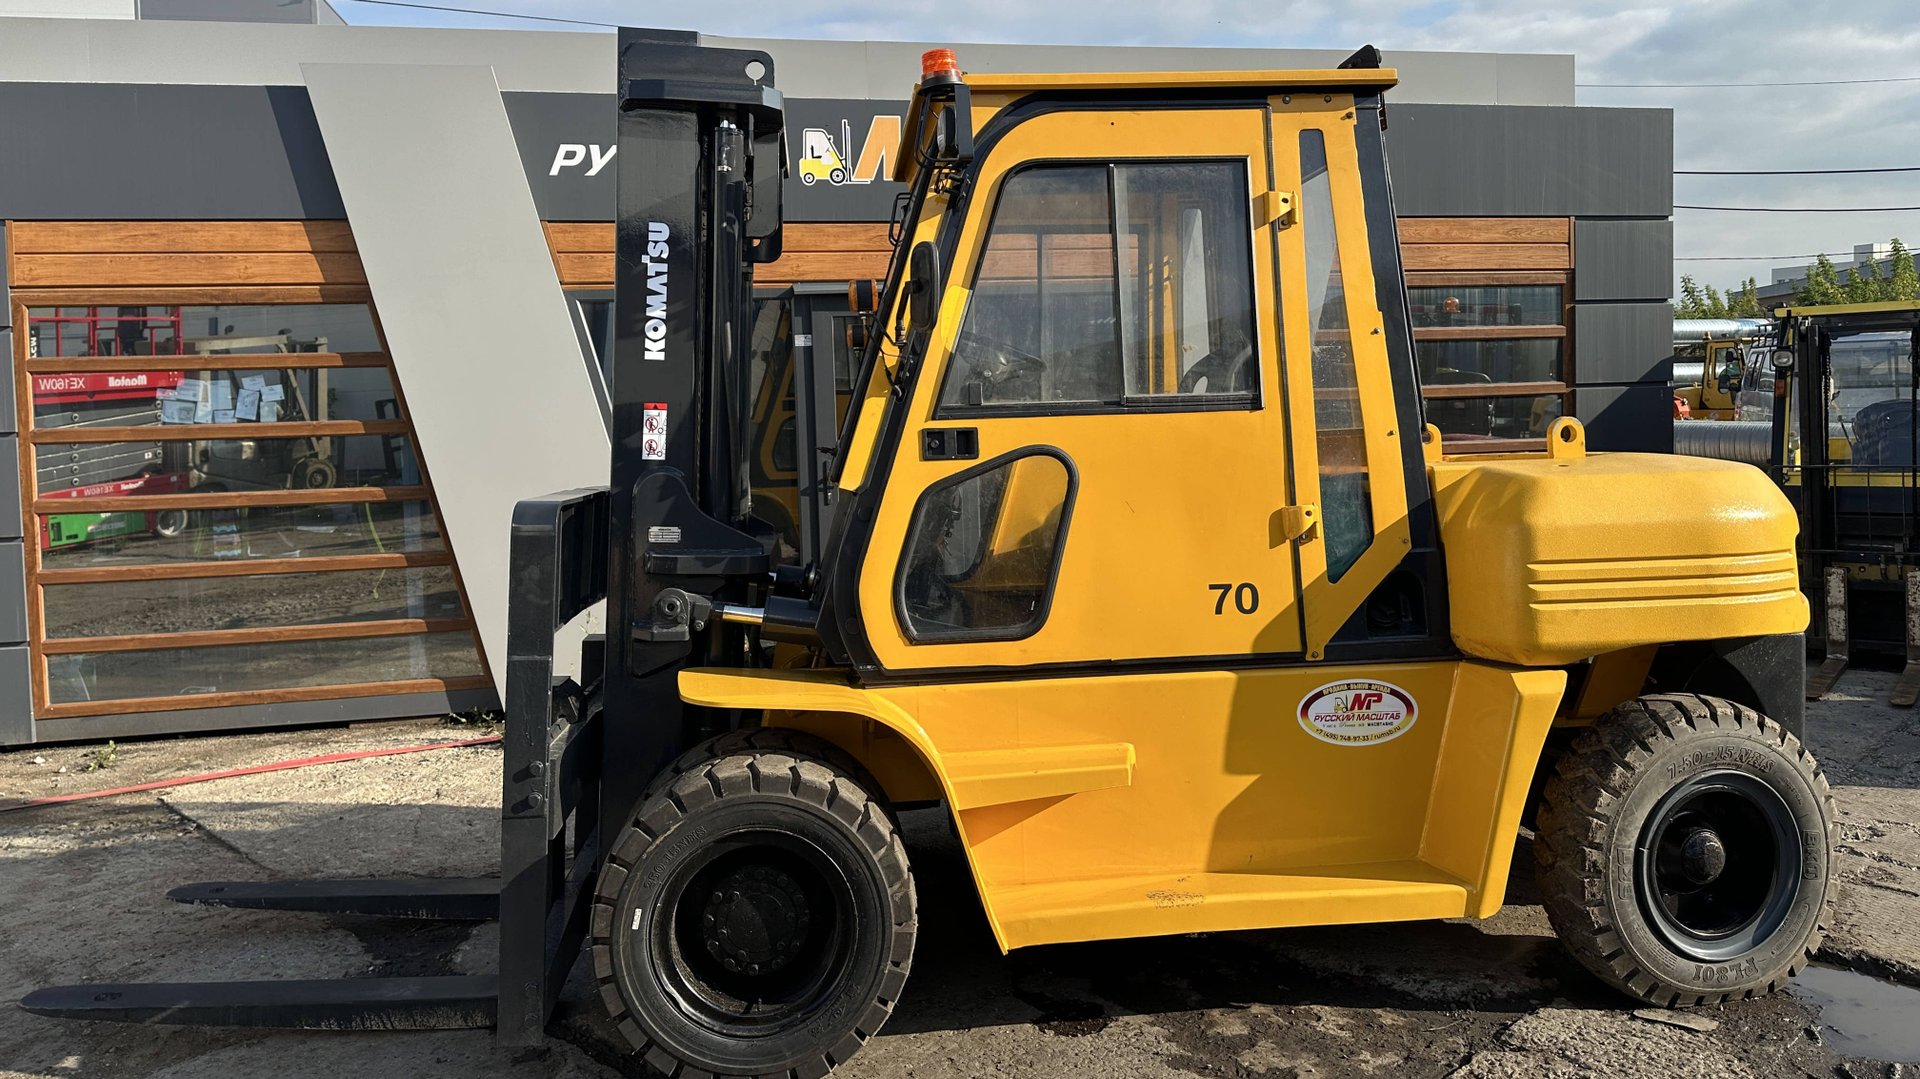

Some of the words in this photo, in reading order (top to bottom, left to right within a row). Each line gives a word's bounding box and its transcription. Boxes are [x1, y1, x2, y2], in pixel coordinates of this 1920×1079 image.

[641, 222, 670, 360] KOMATSU
[1208, 582, 1260, 616] 70
[1314, 713, 1355, 722] РУССКИЙ
[1356, 712, 1401, 721] МАСШТАБ
[1323, 731, 1339, 741] (495)
